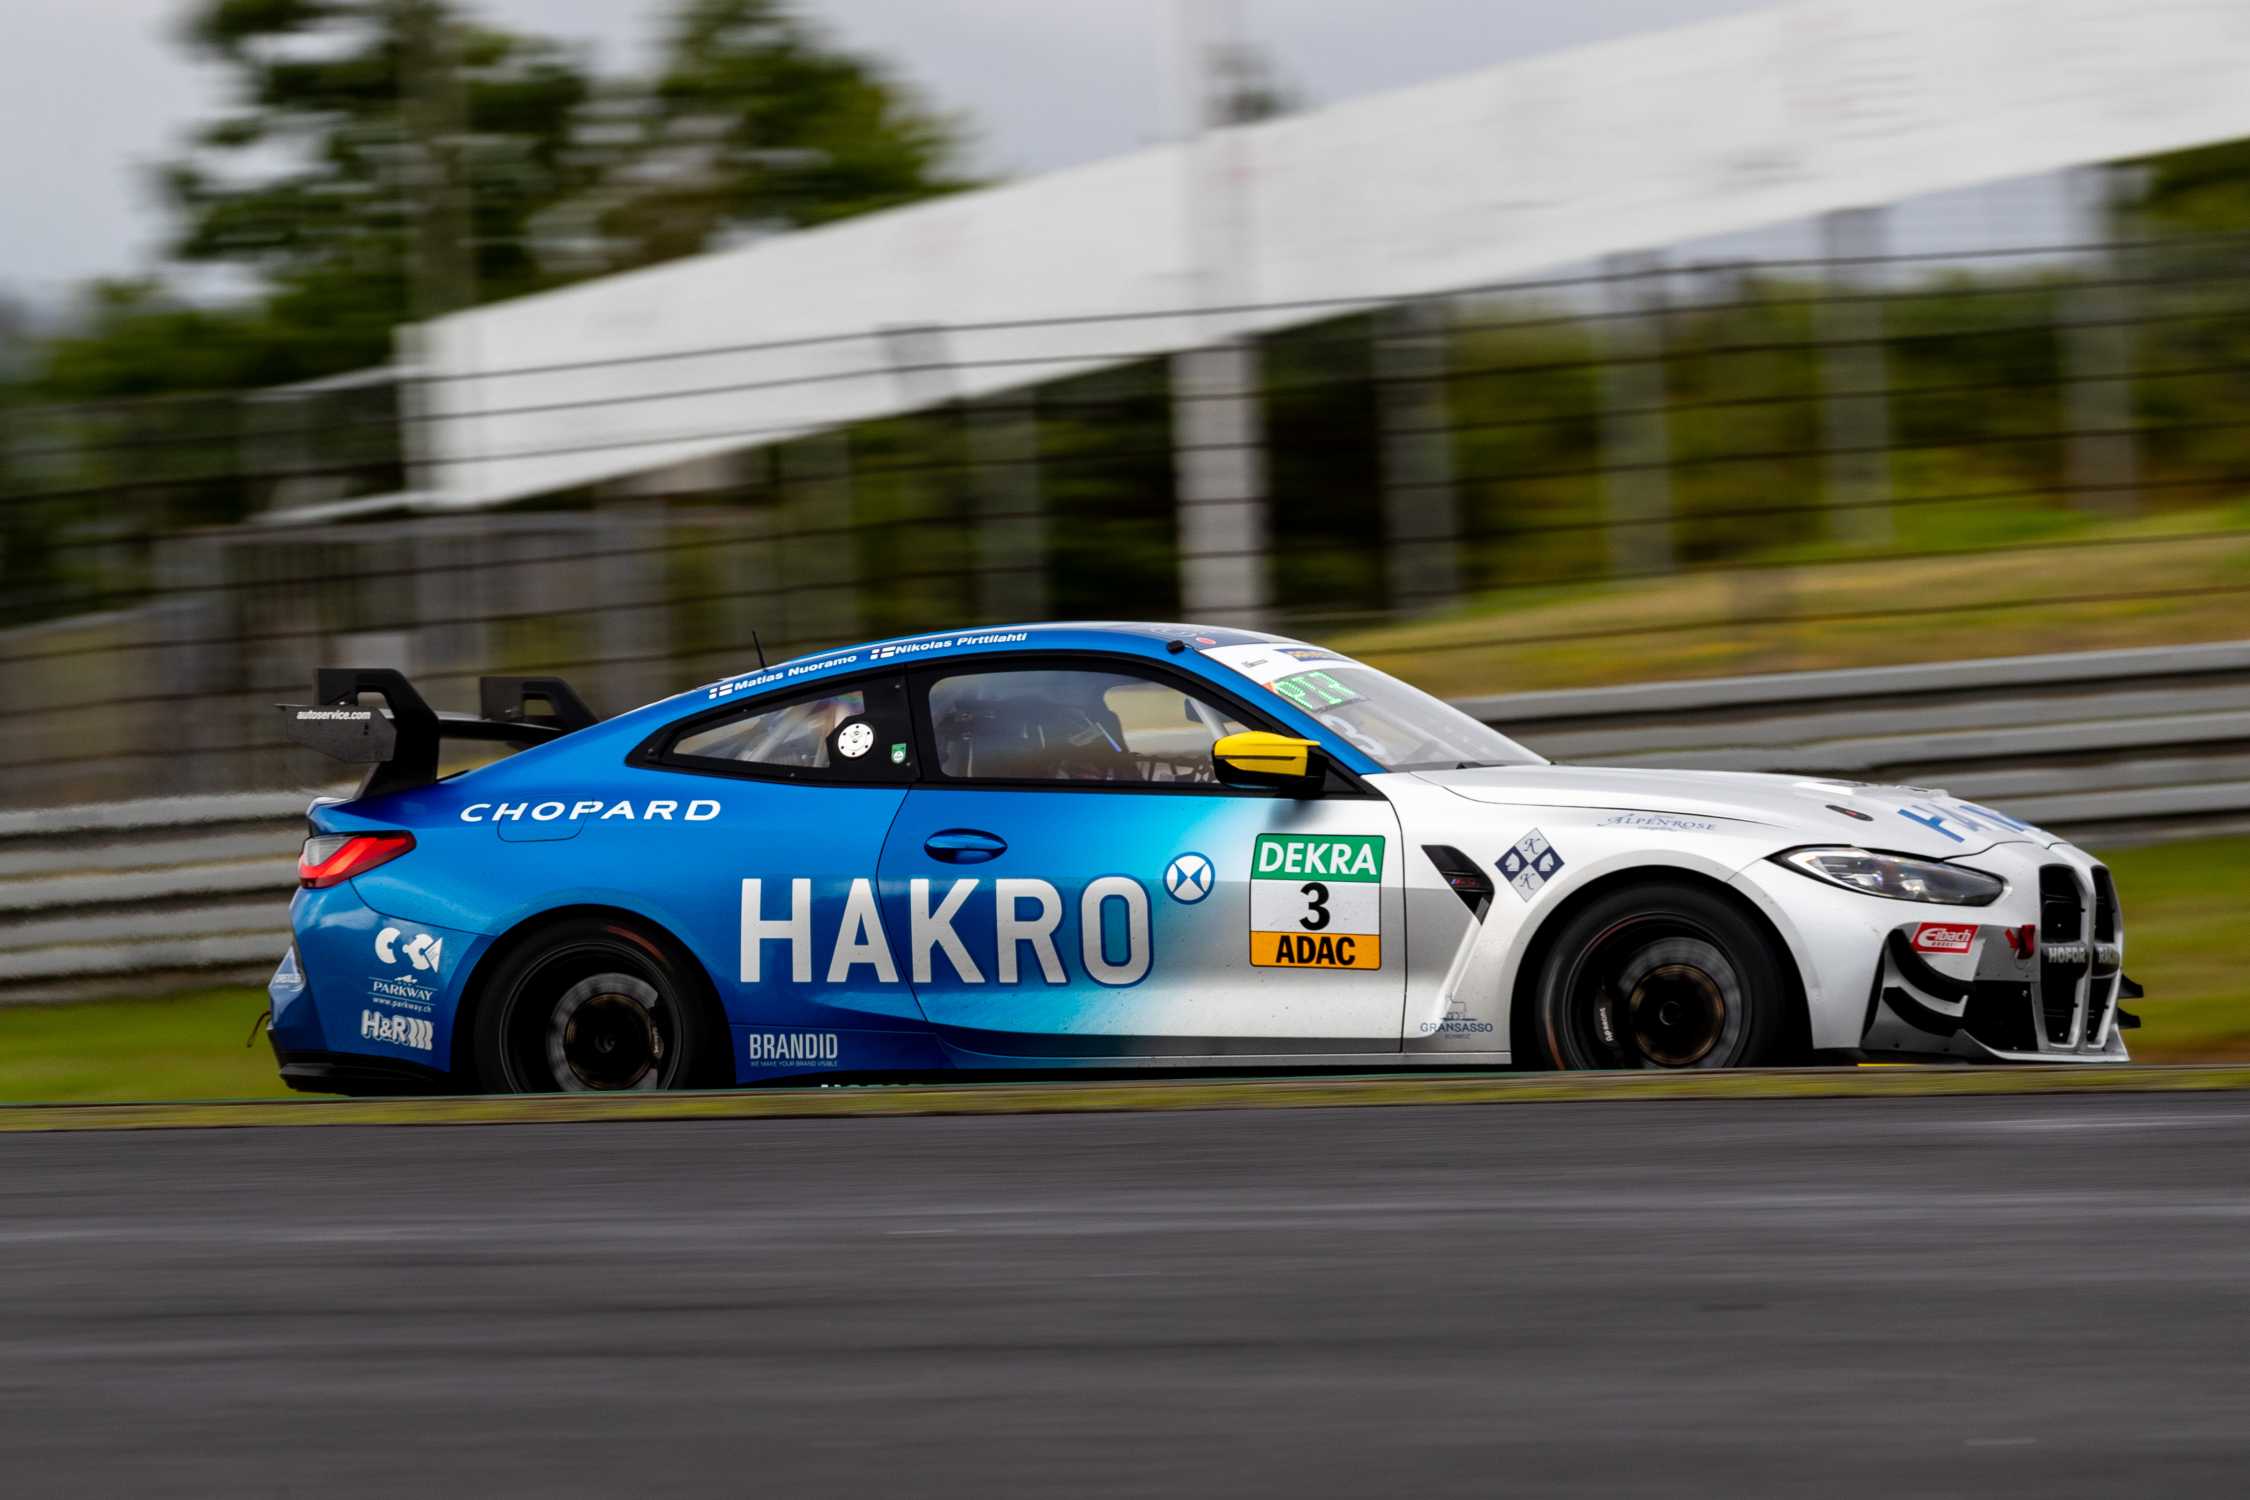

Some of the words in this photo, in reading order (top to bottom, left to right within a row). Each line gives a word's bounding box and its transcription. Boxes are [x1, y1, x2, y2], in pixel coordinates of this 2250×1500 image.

[895, 641, 952, 654] Nikolas
[956, 632, 1028, 647] Pirttilahti
[734, 672, 784, 691] Matias
[788, 655, 857, 677] Nuoramo
[296, 709, 371, 720] autoservice.com
[459, 800, 722, 822] CHOPARD
[1258, 841, 1377, 875] DEKRA
[1298, 881, 1331, 931] 3
[740, 876, 1155, 989] HAKRO
[1917, 927, 1972, 949] Eibach
[1275, 935, 1356, 966] ADAC
[373, 981, 433, 1001] PARKWAY
[361, 1009, 410, 1047] H&R
[1420, 1022, 1494, 1033] GRANSASSO
[750, 1033, 838, 1060] BRANDID
